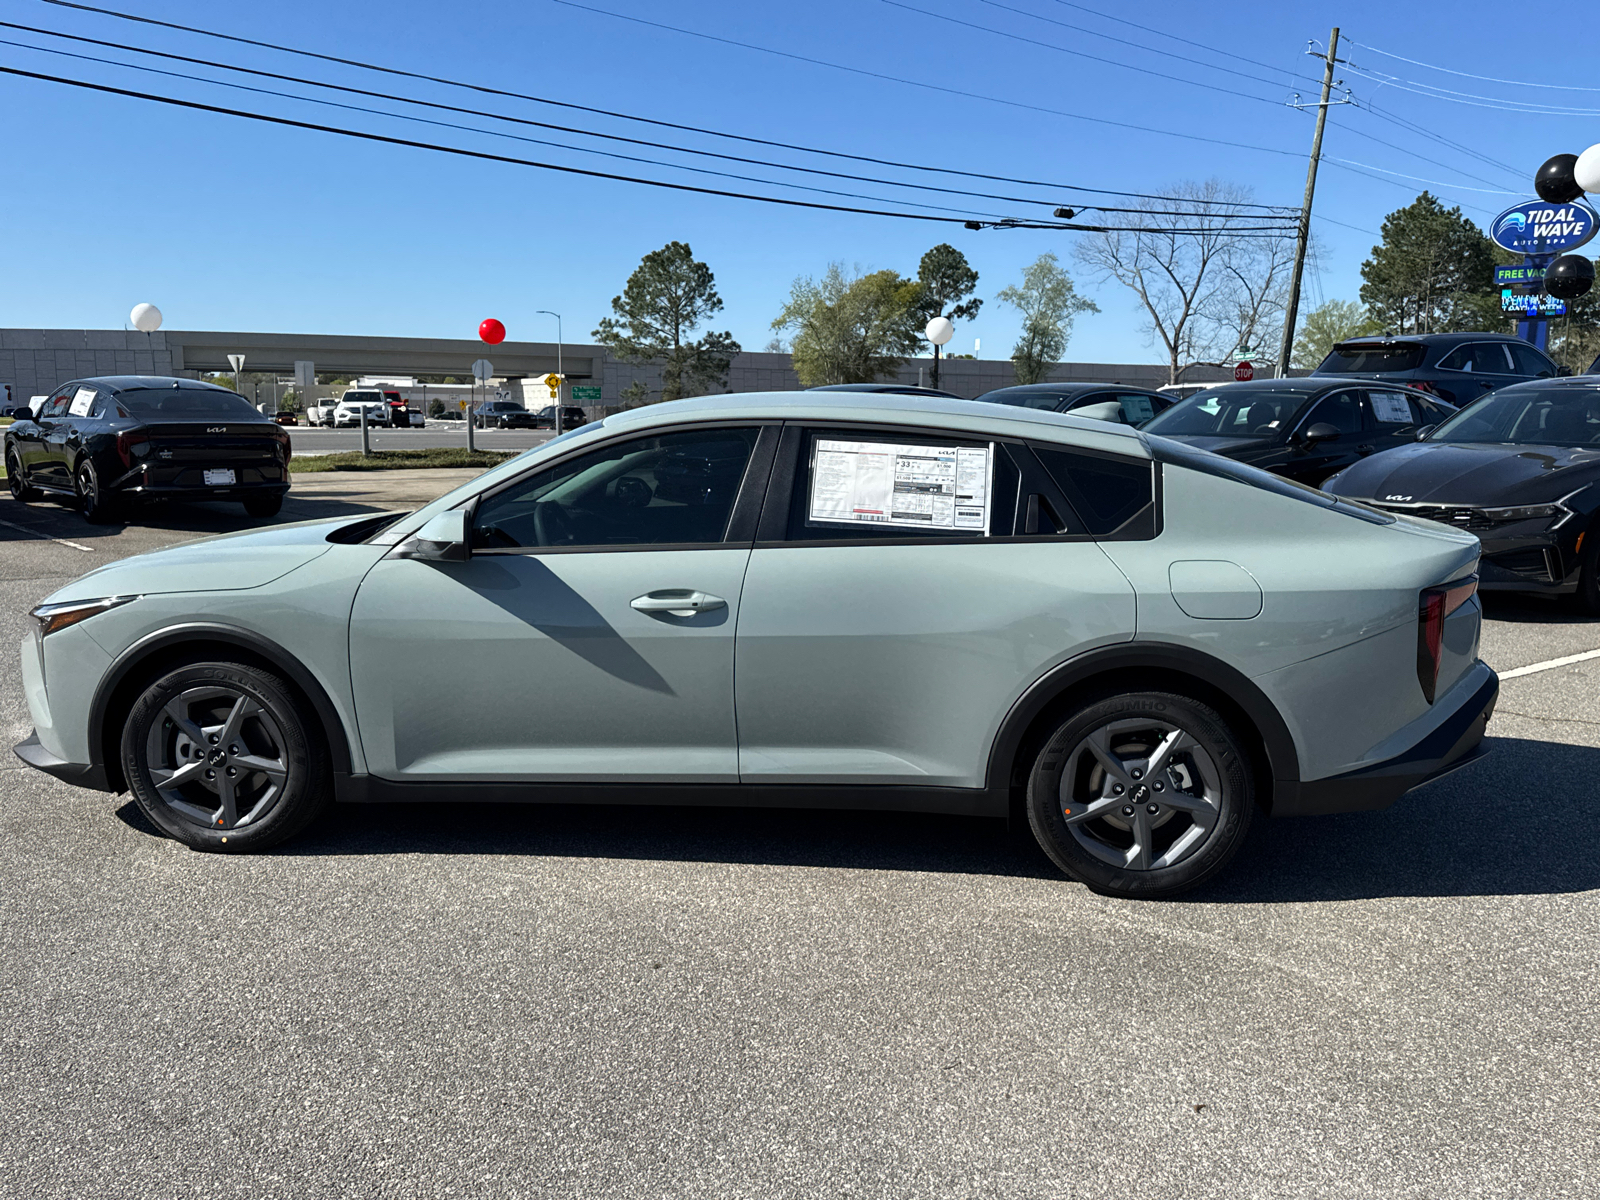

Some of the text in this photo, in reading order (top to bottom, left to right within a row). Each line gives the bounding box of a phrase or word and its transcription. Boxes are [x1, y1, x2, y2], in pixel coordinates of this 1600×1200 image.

[1527, 208, 1575, 224] TIDAL
[1533, 221, 1585, 238] WAVE
[1498, 268, 1547, 279] FREE VAC
[1235, 368, 1253, 378] STOP
[900, 460, 911, 468] 33
[1385, 494, 1413, 502] KIA
[210, 751, 225, 766] KIA
[1132, 785, 1147, 803] KIA
